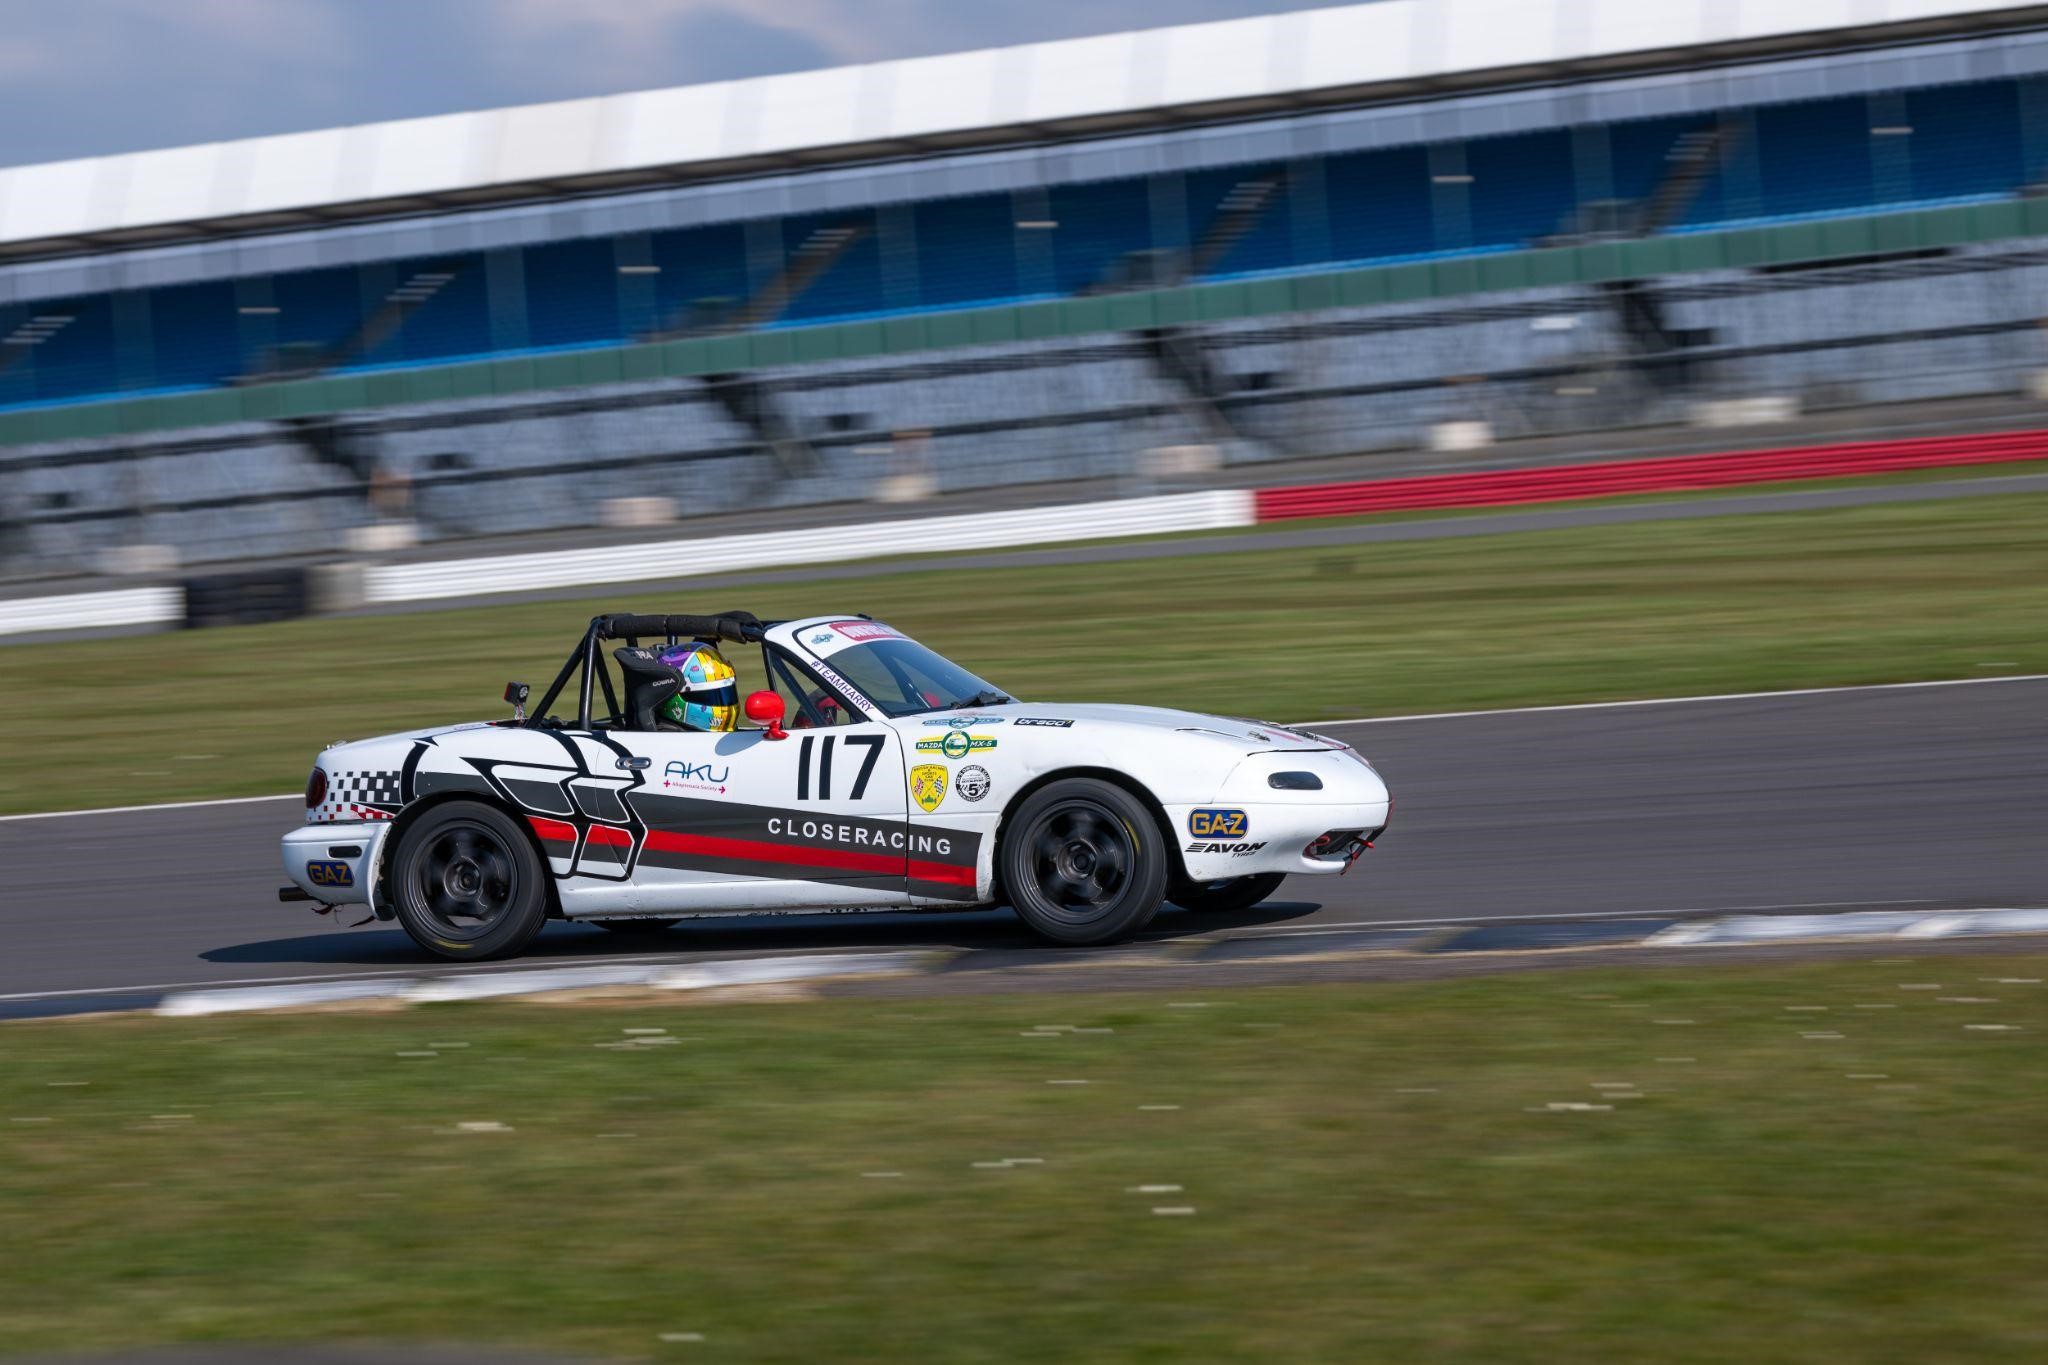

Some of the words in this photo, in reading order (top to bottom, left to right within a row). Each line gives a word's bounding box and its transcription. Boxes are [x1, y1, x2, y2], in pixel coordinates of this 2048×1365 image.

[810, 660, 874, 712] #TEAMHARRY
[664, 760, 729, 783] AKU
[797, 734, 886, 801] 117
[1191, 813, 1245, 835] GAZ
[767, 818, 952, 855] CLOSERACING
[1203, 841, 1268, 853] AVON
[309, 864, 352, 884] GAZ
